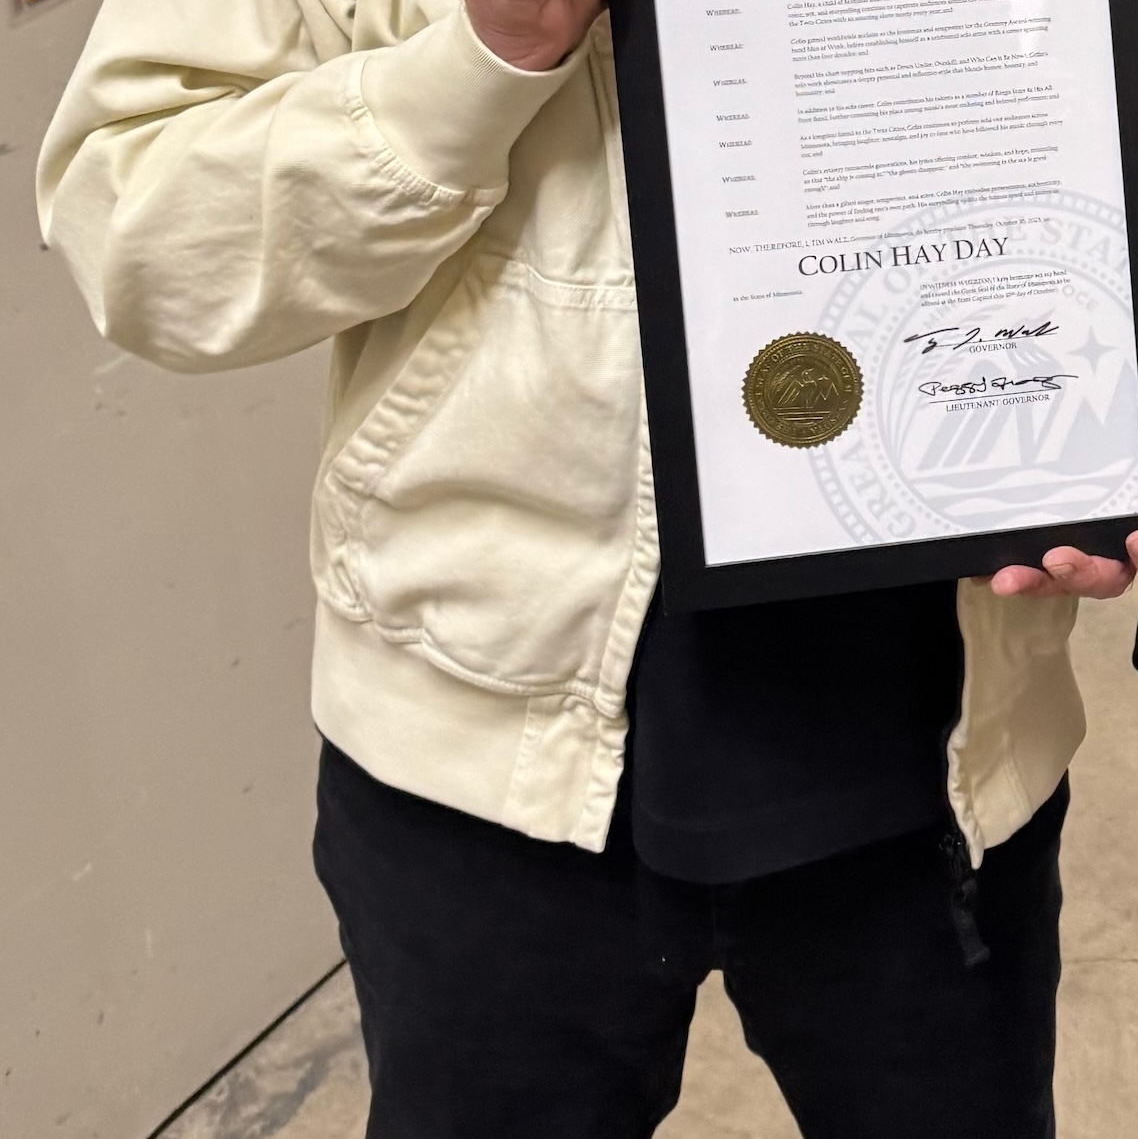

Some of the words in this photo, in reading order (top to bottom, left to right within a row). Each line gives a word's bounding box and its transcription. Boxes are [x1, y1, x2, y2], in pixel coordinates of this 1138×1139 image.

[797, 248, 883, 276] COLIN
[890, 241, 948, 266] HAY
[953, 235, 1009, 260] DAY
[968, 341, 1017, 354] GOVERNOR
[945, 398, 1000, 412] LIEUTENANT
[1001, 393, 1050, 406] GOVERNOR
